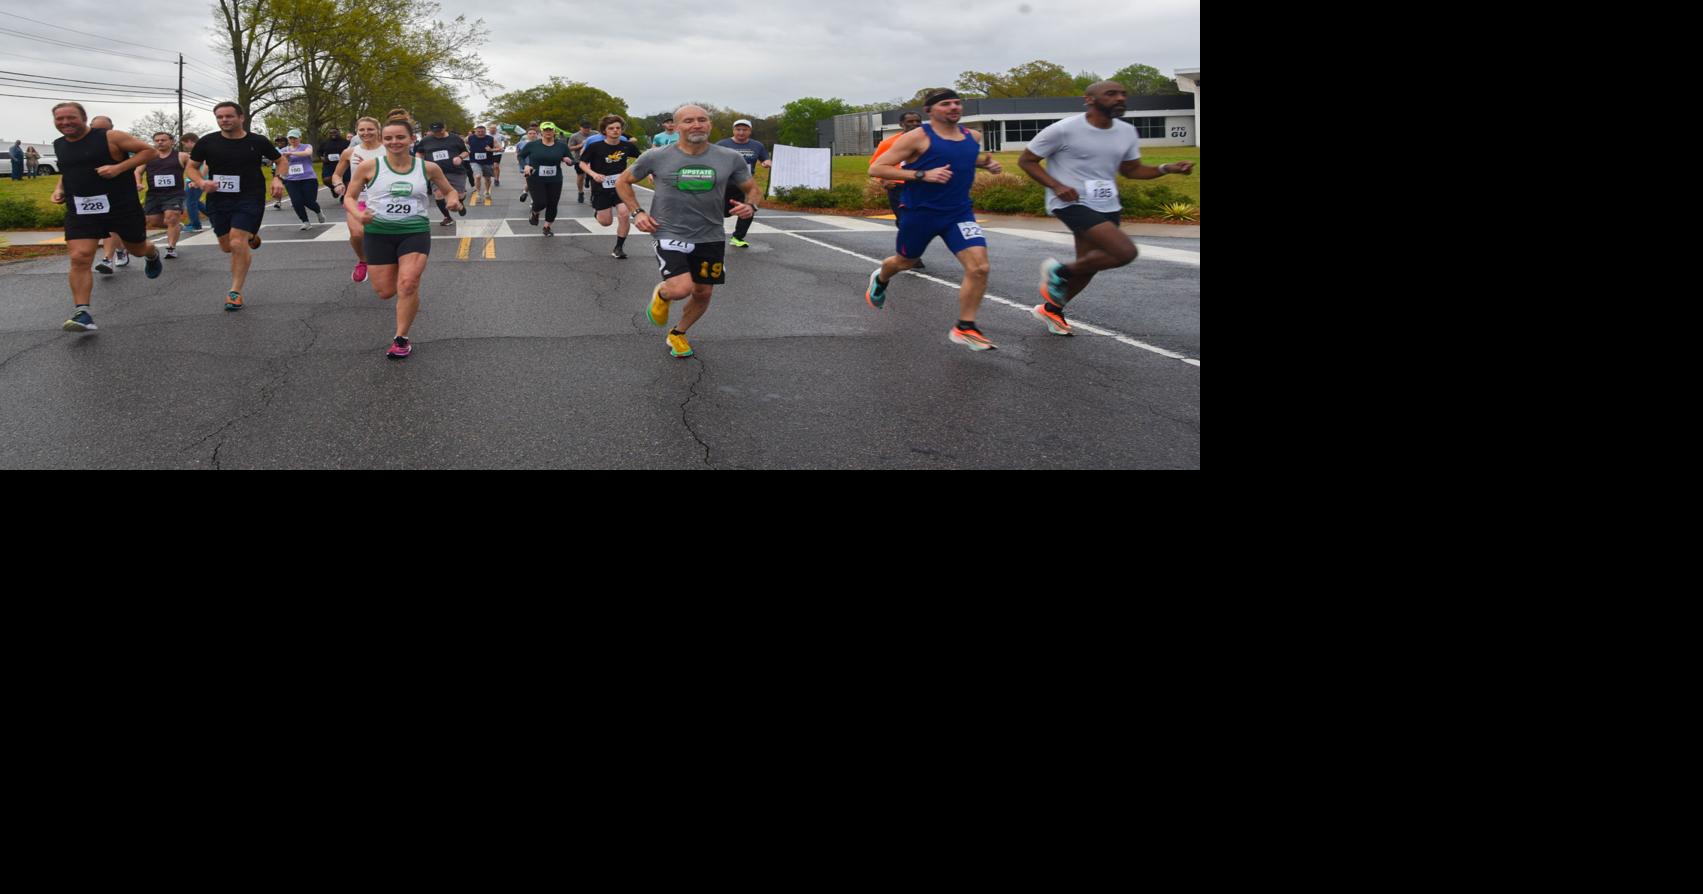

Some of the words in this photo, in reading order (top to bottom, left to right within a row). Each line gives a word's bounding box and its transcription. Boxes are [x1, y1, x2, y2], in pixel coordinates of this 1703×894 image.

[217, 181, 234, 189] 175
[606, 178, 617, 186] 19
[81, 202, 104, 211] 228
[386, 204, 411, 213] 229
[962, 226, 982, 237] 22
[700, 261, 722, 278] 19
